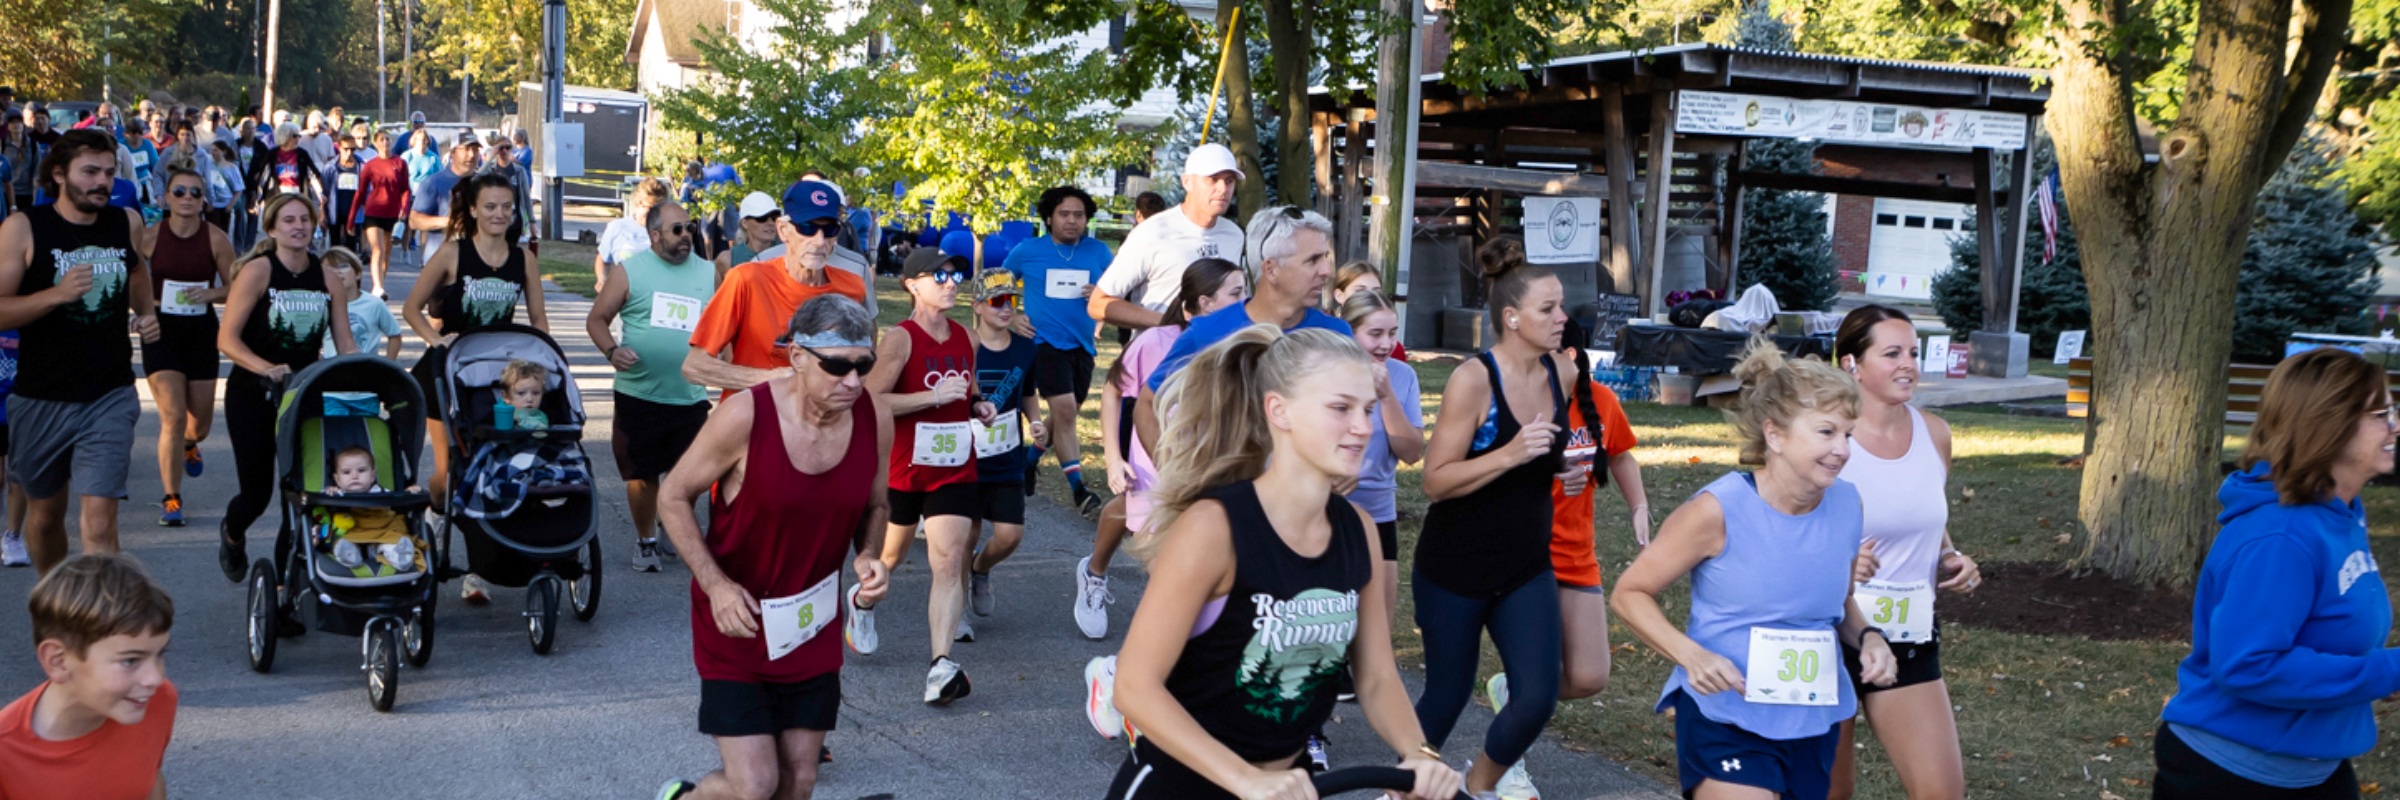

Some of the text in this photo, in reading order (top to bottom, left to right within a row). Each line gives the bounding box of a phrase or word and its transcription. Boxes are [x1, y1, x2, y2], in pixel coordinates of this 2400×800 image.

[811, 190, 829, 207] C
[51, 246, 128, 263] Regenerative
[54, 259, 127, 277] Rners
[667, 302, 689, 320] 70
[931, 433, 957, 454] 35
[984, 423, 1008, 445] 77
[797, 602, 814, 630] 8
[1250, 588, 1359, 623] Regenerati
[1873, 596, 1910, 624] 31
[1252, 616, 1358, 653] Runner
[1777, 648, 1820, 683] 30
